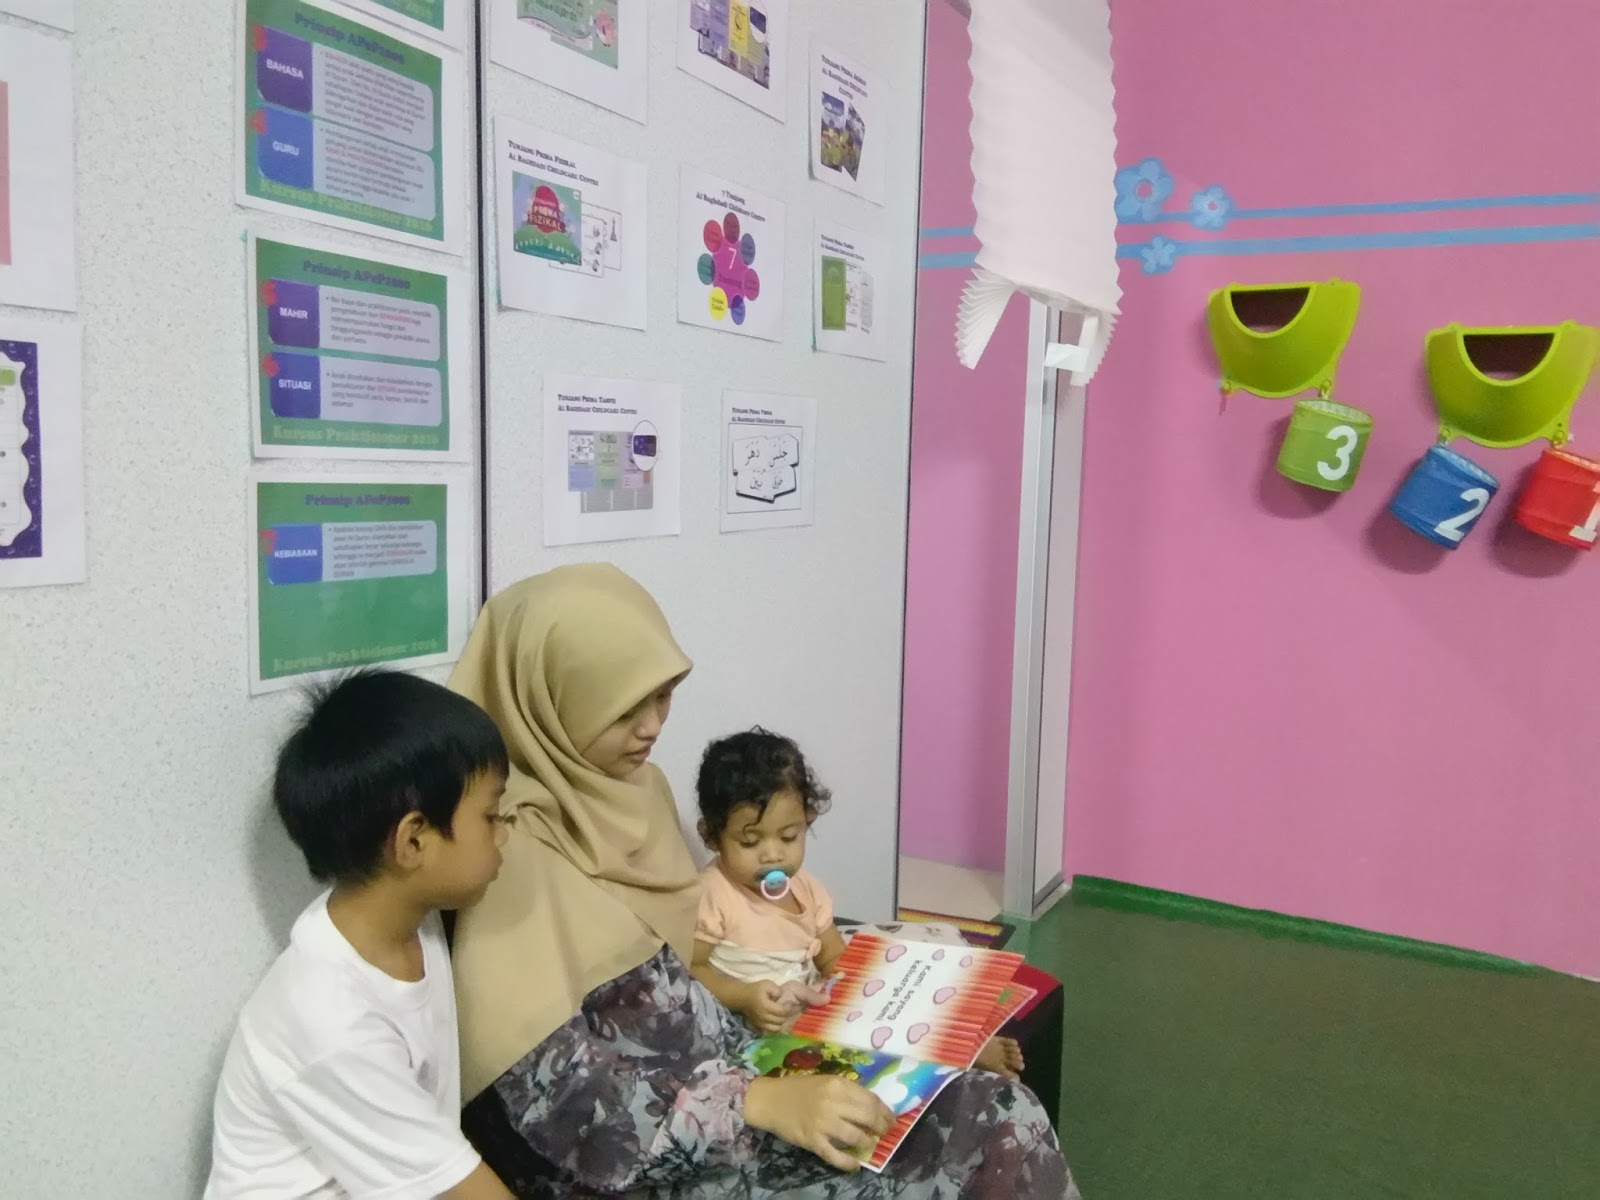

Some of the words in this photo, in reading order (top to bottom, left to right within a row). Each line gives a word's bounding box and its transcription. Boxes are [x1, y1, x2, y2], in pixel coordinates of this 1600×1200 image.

[266, 58, 304, 79] BAHASA
[272, 140, 299, 156] GURU
[508, 139, 534, 155] TUNJANG
[536, 149, 553, 161] PRIMA
[508, 152, 516, 161] AL
[518, 155, 546, 170] BAGHDADI
[547, 165, 578, 180] CHILDCARE
[579, 174, 599, 186] CENTRE
[696, 192, 703, 200] Al
[703, 193, 728, 208] Baghdadi
[729, 203, 750, 216] Childcare
[751, 211, 766, 222] Centre
[529, 214, 562, 231] FIZIKAL
[727, 247, 737, 270] 7
[279, 307, 309, 319] MAHIR
[278, 379, 312, 390] SITUASI
[558, 394, 581, 402] TUNJANG
[582, 395, 598, 403] PRIMA
[566, 405, 591, 413] BAGHDADI
[592, 406, 619, 414] CHILDCARE
[620, 407, 638, 415] CENTRE
[1317, 424, 1358, 481] 3
[1433, 487, 1490, 542] 2
[1569, 480, 1600, 542] 1
[274, 549, 318, 558] KEBIASAAN
[892, 959, 923, 998] keluarga
[913, 964, 932, 986] Kami
[887, 989, 915, 1020] sayang
